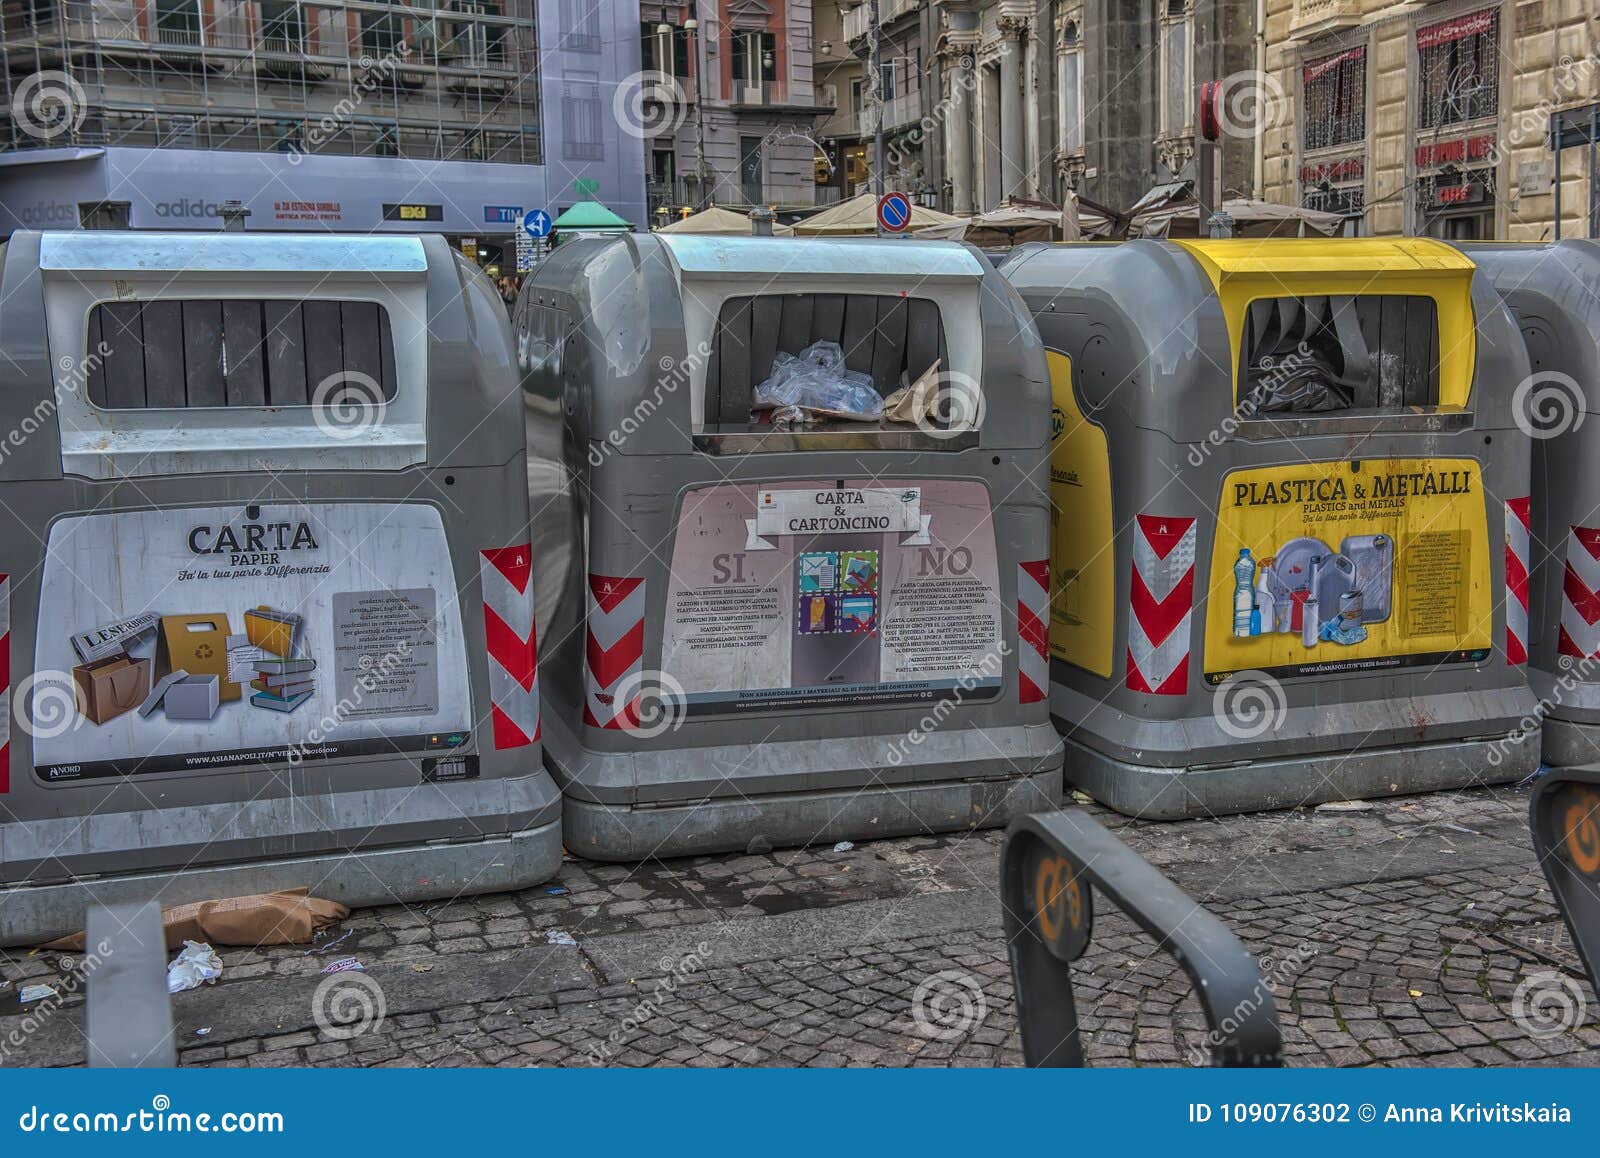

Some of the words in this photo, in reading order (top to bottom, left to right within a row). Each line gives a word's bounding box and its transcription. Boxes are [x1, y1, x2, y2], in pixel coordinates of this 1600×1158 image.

[155, 199, 219, 218] adida
[499, 208, 521, 222] TIM
[1234, 478, 1347, 507] PLASTICA
[1354, 484, 1366, 499] &
[1372, 471, 1470, 498] METALLI
[815, 491, 864, 505] CARTA
[834, 505, 846, 516] &
[1303, 502, 1346, 513] PLASTICS
[1349, 500, 1366, 511] and
[789, 516, 890, 532] CARTONCINO
[188, 522, 319, 554] CARTA
[230, 552, 280, 566] PAPER
[917, 546, 973, 577] NO
[197, 570, 209, 579] la
[213, 568, 232, 578] tua
[232, 566, 262, 580] parte
[264, 563, 331, 579] Differenzia
[713, 553, 746, 584] SI
[58, 765, 81, 775] NORD
